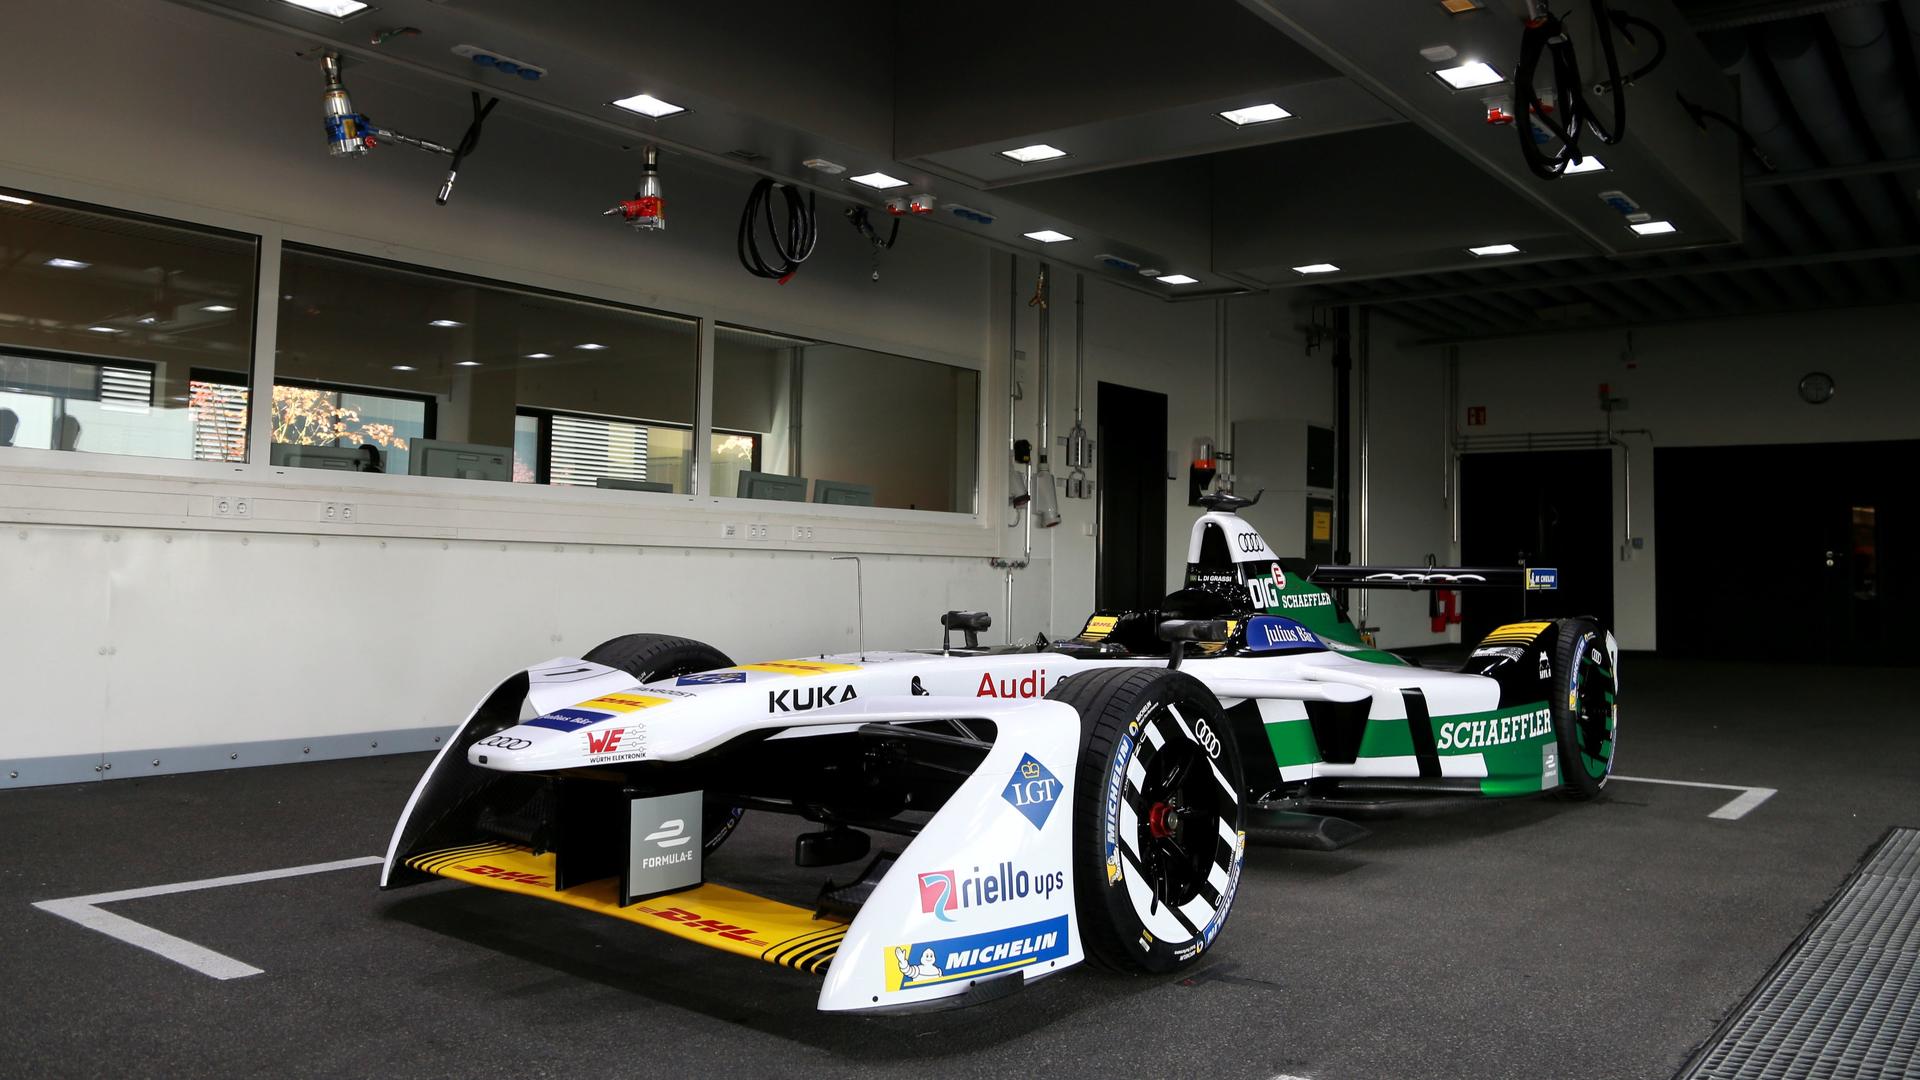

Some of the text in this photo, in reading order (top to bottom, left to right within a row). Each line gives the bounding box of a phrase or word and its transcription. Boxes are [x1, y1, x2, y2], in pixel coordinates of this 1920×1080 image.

[1210, 575, 1232, 583] GRASSI
[1273, 567, 1284, 585] E
[1535, 575, 1555, 583] MCHELIN
[1248, 577, 1280, 609] DIG
[1281, 592, 1332, 609] SCHAEFFLER
[1263, 624, 1316, 646] Julius Bär
[976, 669, 1046, 699] Audi
[769, 684, 858, 713] KUKA
[587, 728, 625, 754] WE
[1437, 708, 1552, 750] SCHAEFFLER
[590, 752, 647, 764] WÜRTH ELEKTRONIK
[1012, 778, 1056, 806] LGT
[1106, 739, 1130, 845] MICHELIN
[962, 861, 1064, 908] riello ups
[650, 907, 759, 942] DHL
[945, 931, 1058, 970] MICHELIN
